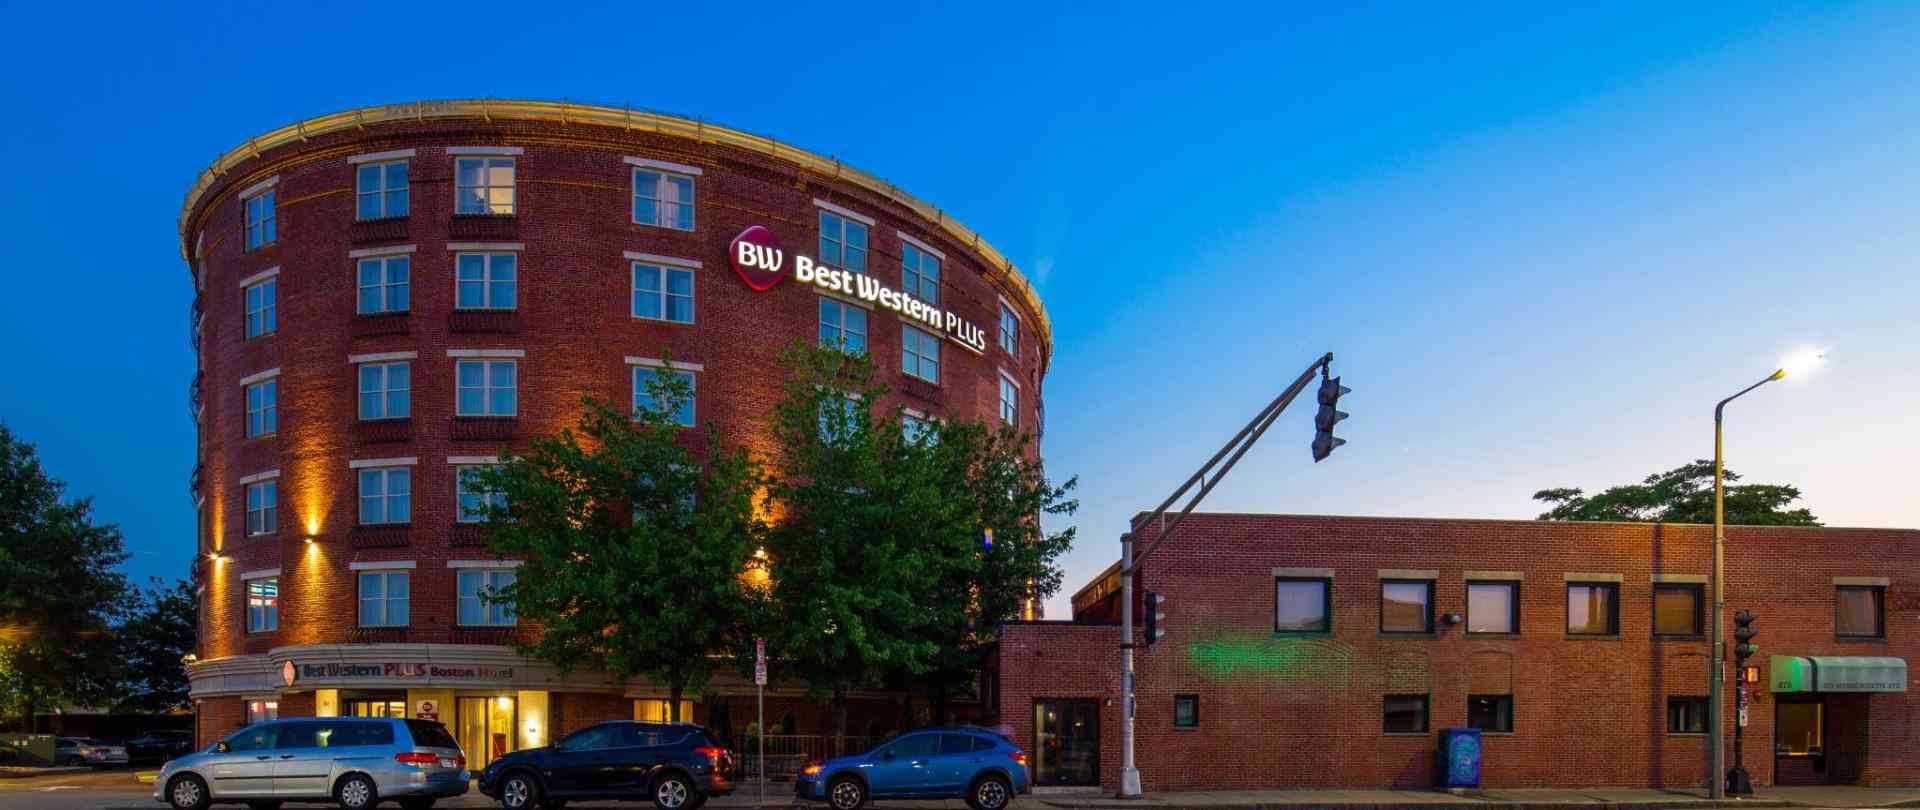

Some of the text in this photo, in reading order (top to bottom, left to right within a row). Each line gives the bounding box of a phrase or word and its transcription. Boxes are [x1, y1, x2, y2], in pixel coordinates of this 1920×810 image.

[738, 241, 783, 272] BW
[795, 255, 985, 350] Best Western PLUS
[384, 664, 426, 677] PLUS
[431, 666, 474, 677] Boston
